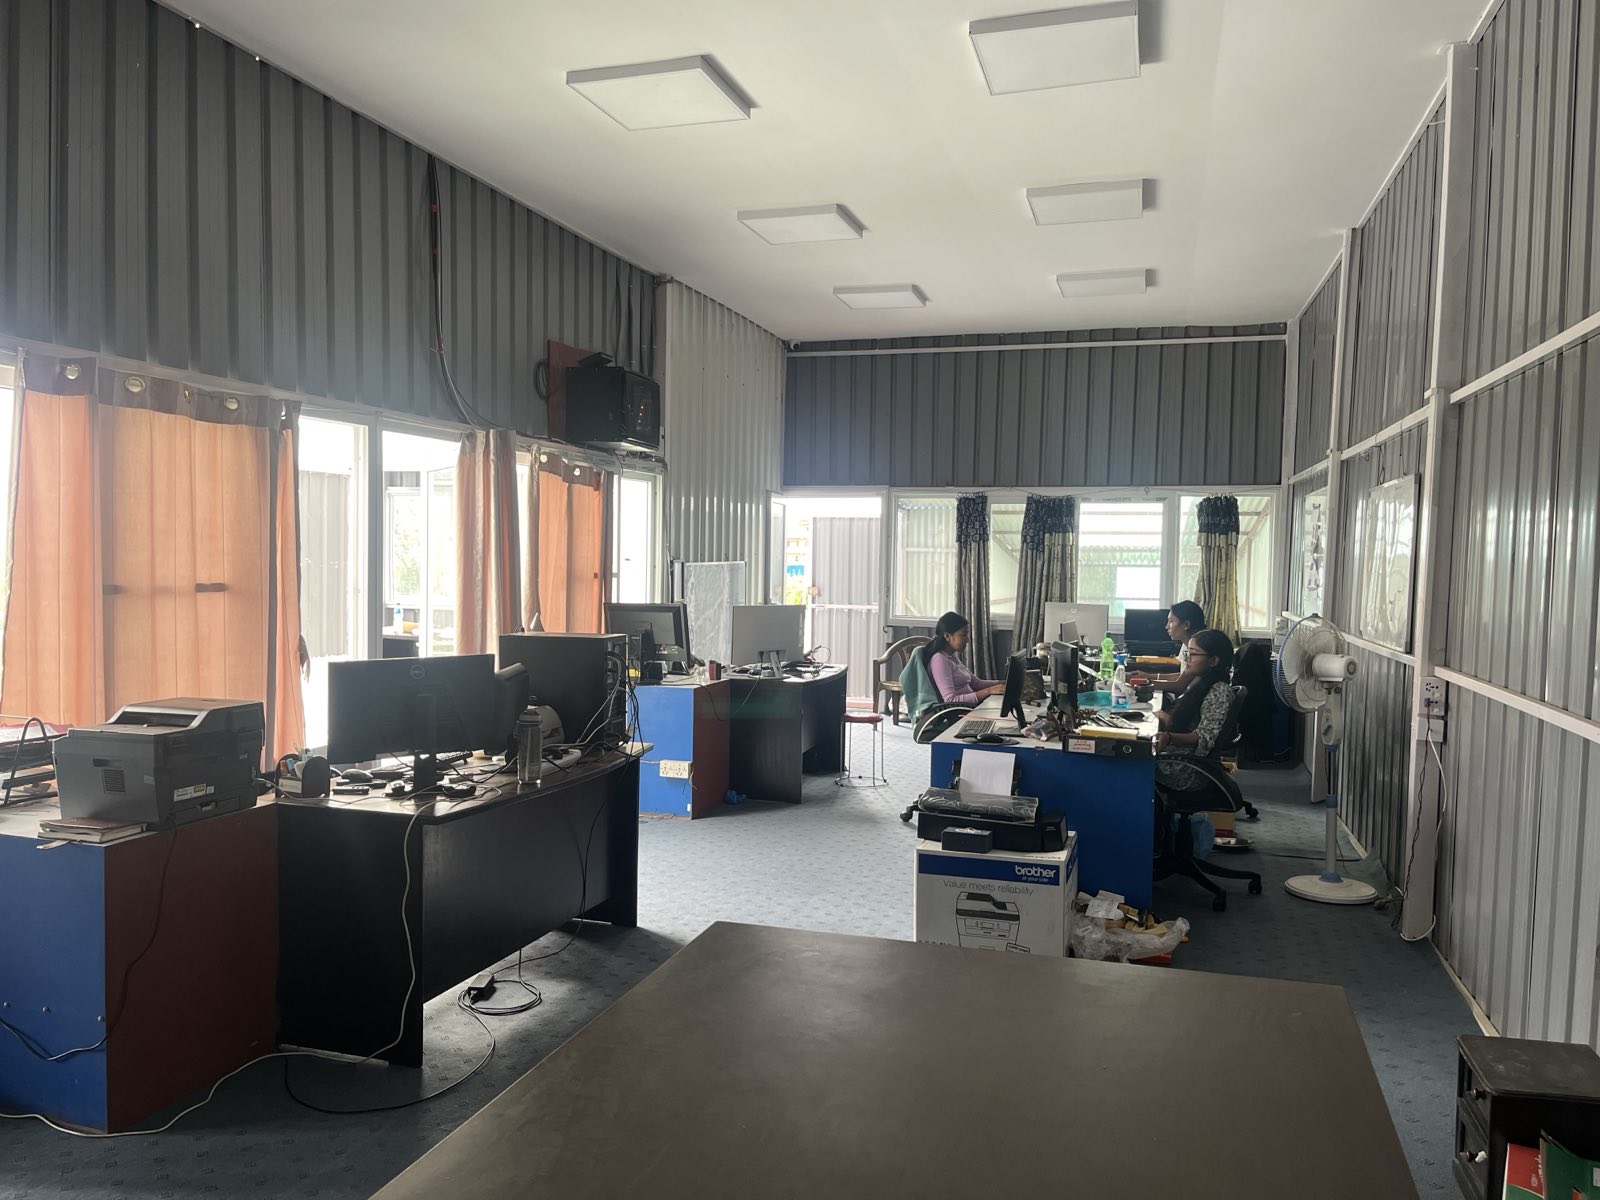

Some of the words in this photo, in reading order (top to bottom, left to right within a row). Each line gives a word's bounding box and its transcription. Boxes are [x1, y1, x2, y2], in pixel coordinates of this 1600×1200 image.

[1015, 865, 1056, 878] brother
[944, 879, 966, 889] Value
[969, 881, 997, 892] meets
[998, 884, 1034, 896] reliability
